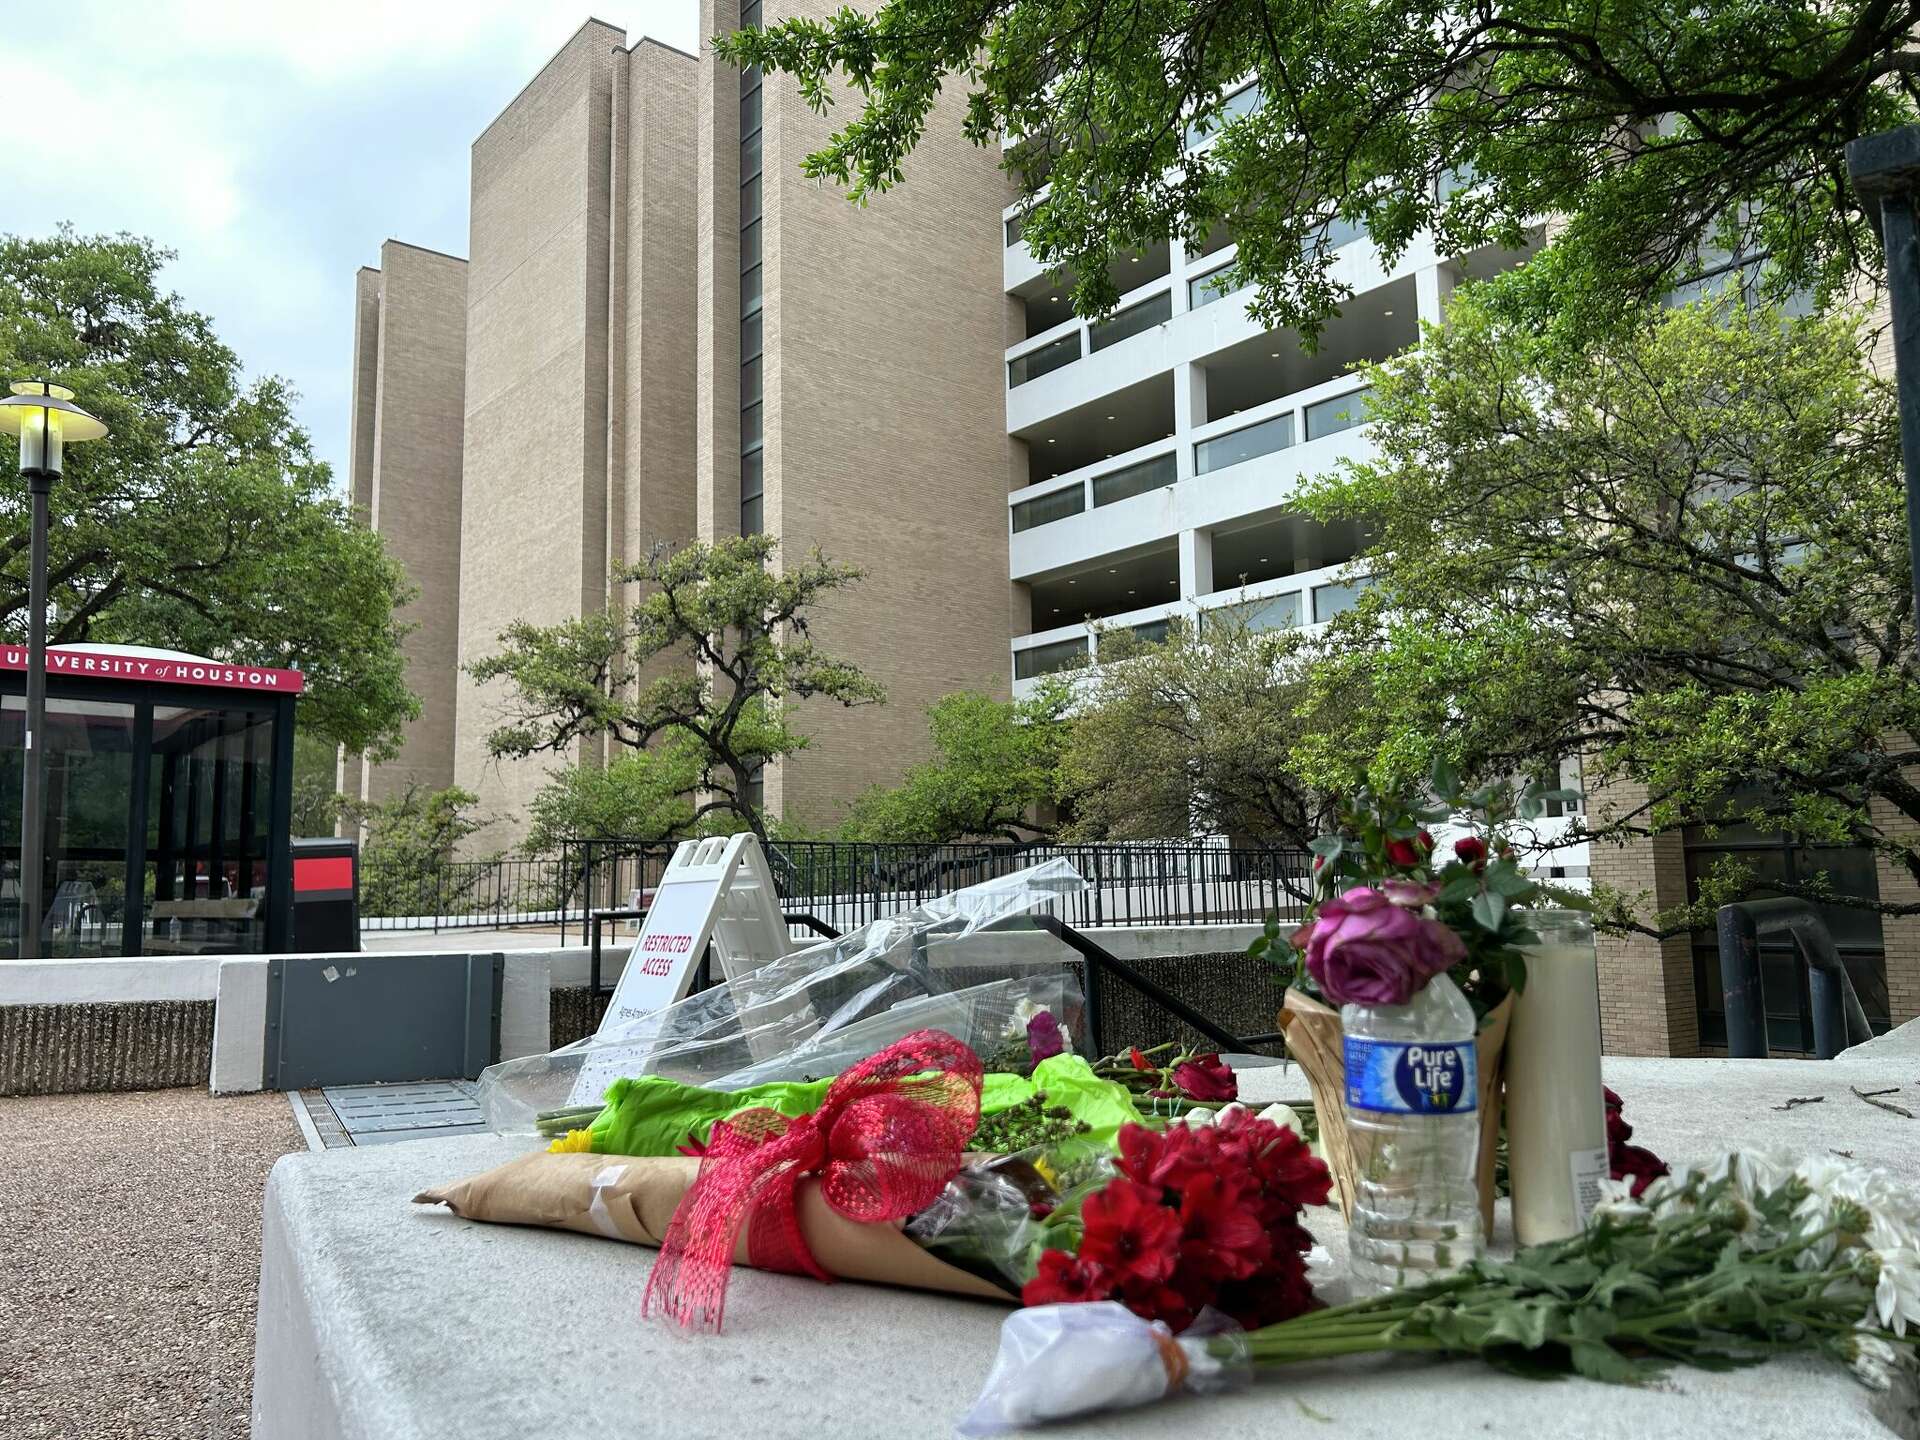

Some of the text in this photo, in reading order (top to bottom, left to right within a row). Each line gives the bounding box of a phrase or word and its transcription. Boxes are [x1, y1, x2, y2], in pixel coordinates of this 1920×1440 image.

[7, 651, 277, 686] UIVERSITY of HOUSTON
[642, 935, 692, 953] RESTRICTED
[640, 958, 673, 976] ACCESS
[1407, 1046, 1456, 1067] Pure
[1414, 1067, 1452, 1092] Life
